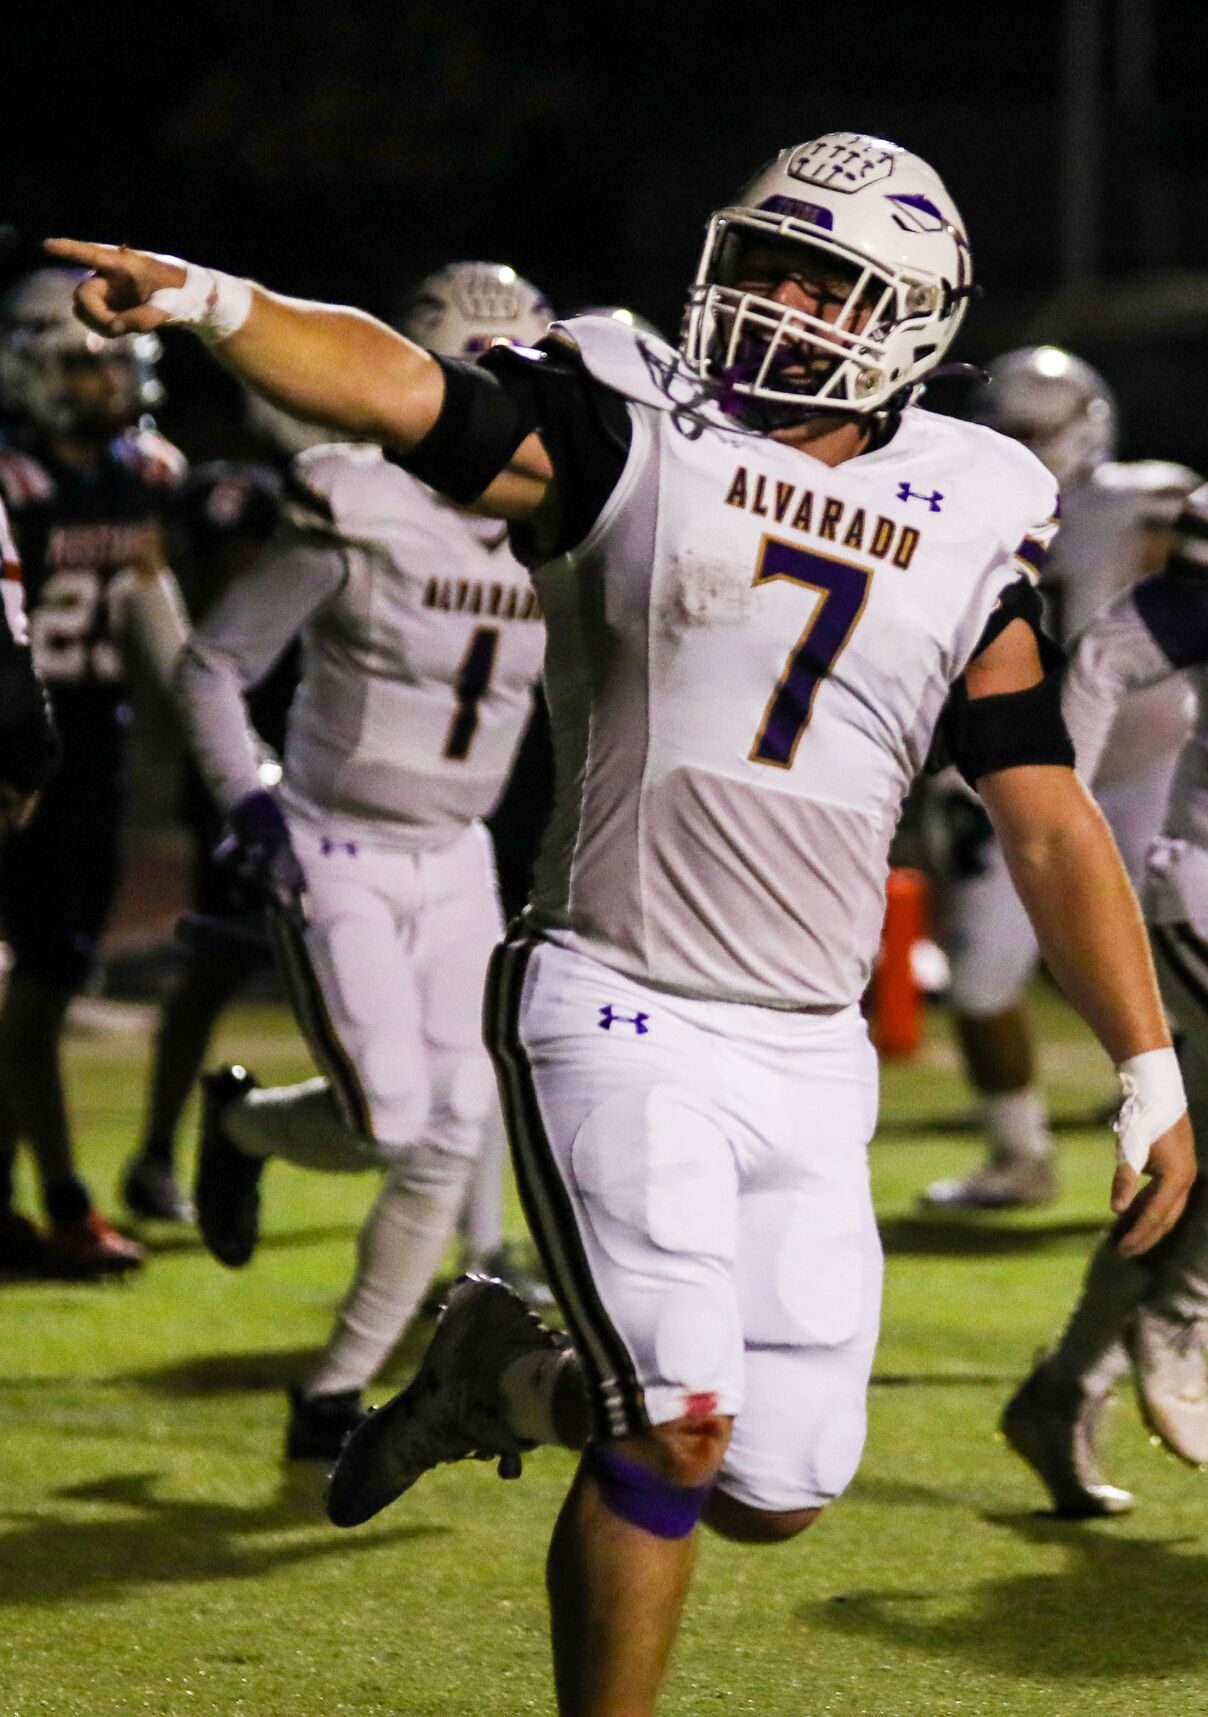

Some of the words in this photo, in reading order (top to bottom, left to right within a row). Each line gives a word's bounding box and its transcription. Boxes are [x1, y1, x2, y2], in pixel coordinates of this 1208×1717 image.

[725, 465, 920, 571] ALVARADO
[422, 577, 543, 621] ALVARAD
[747, 531, 875, 771] 7
[441, 623, 500, 763] 1
